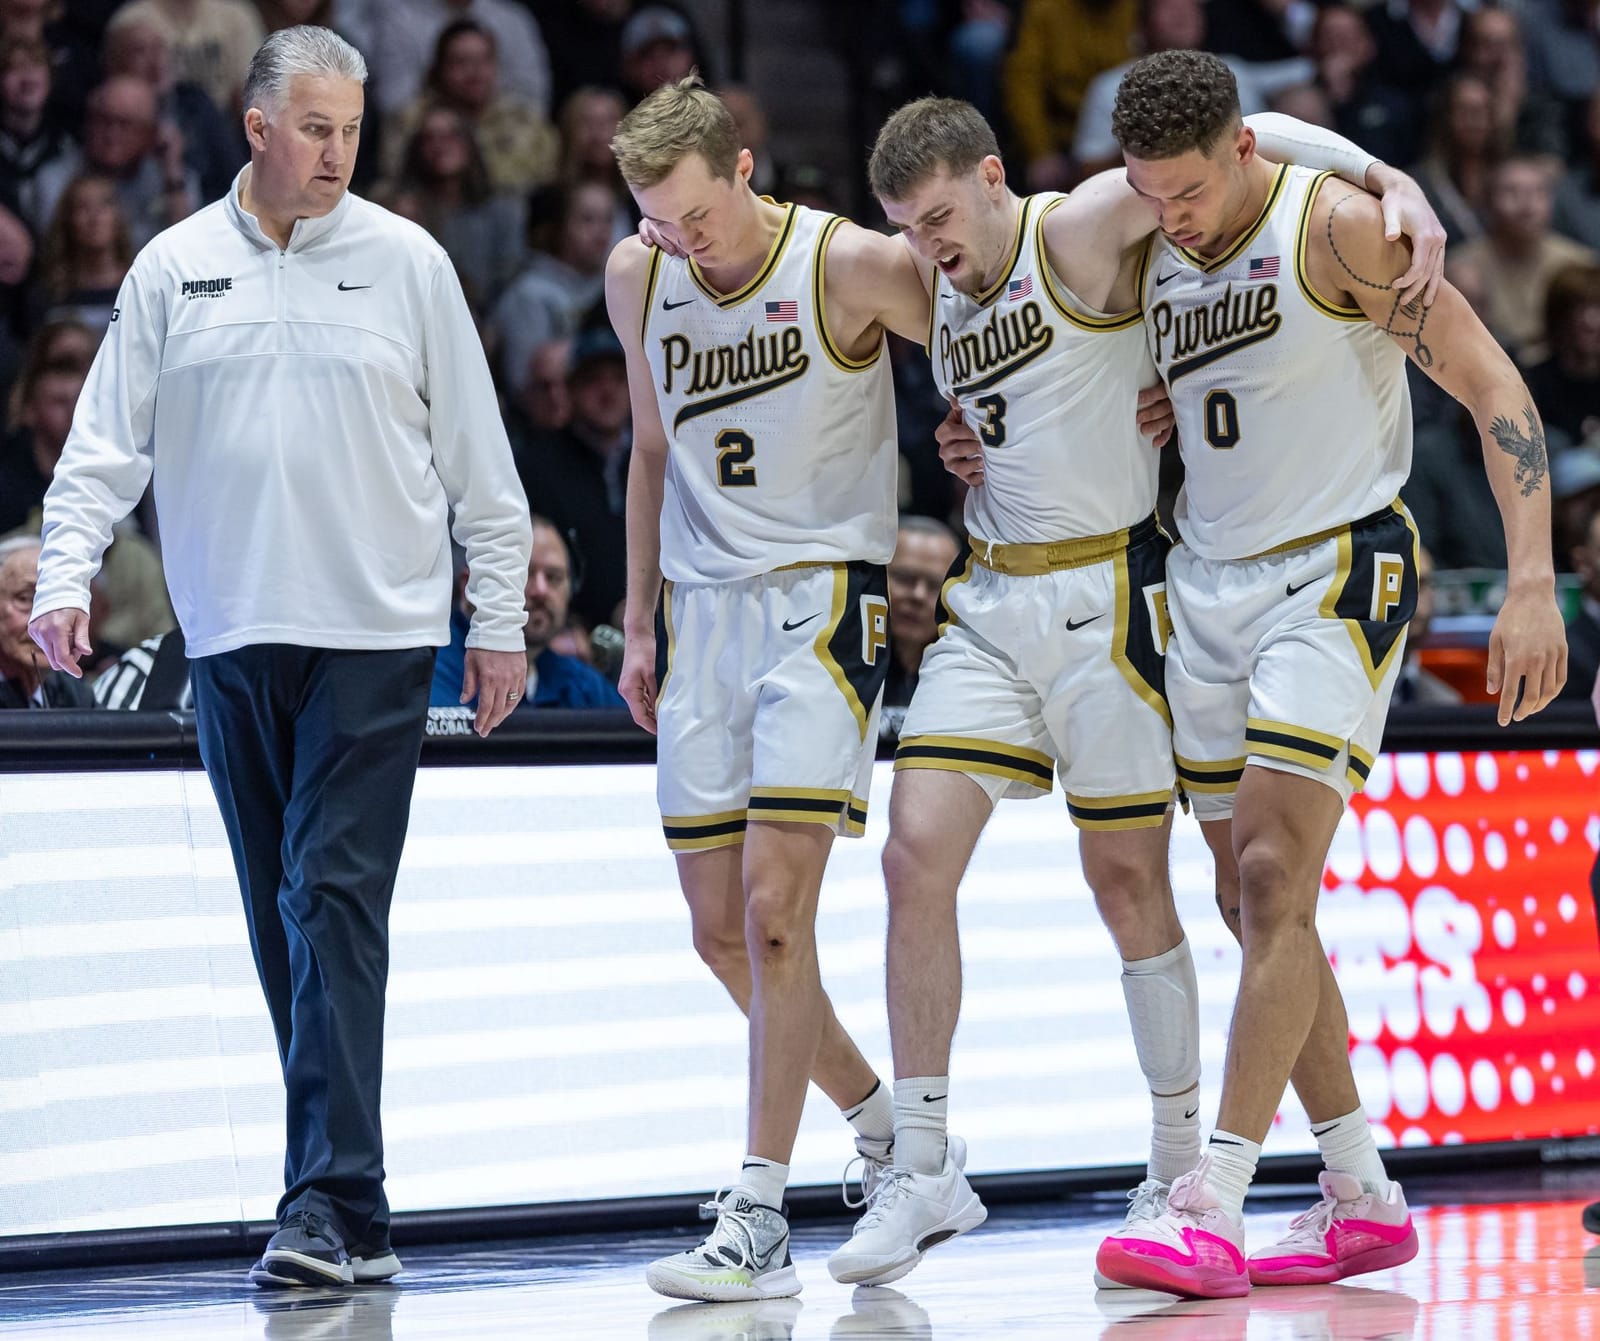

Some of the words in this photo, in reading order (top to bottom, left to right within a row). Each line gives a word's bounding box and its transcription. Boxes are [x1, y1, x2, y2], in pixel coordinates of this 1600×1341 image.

[181, 277, 233, 296] PURDUE
[187, 291, 226, 301] BASKETBALL
[940, 301, 1054, 386] Purdue
[1152, 281, 1282, 364] Purdue
[660, 325, 810, 397] Purdue
[975, 392, 1007, 448] 3
[1204, 388, 1241, 450] 0
[714, 428, 758, 488] 2
[1369, 552, 1405, 622] P
[859, 593, 889, 667] P
[425, 719, 473, 736] GLOBAL
